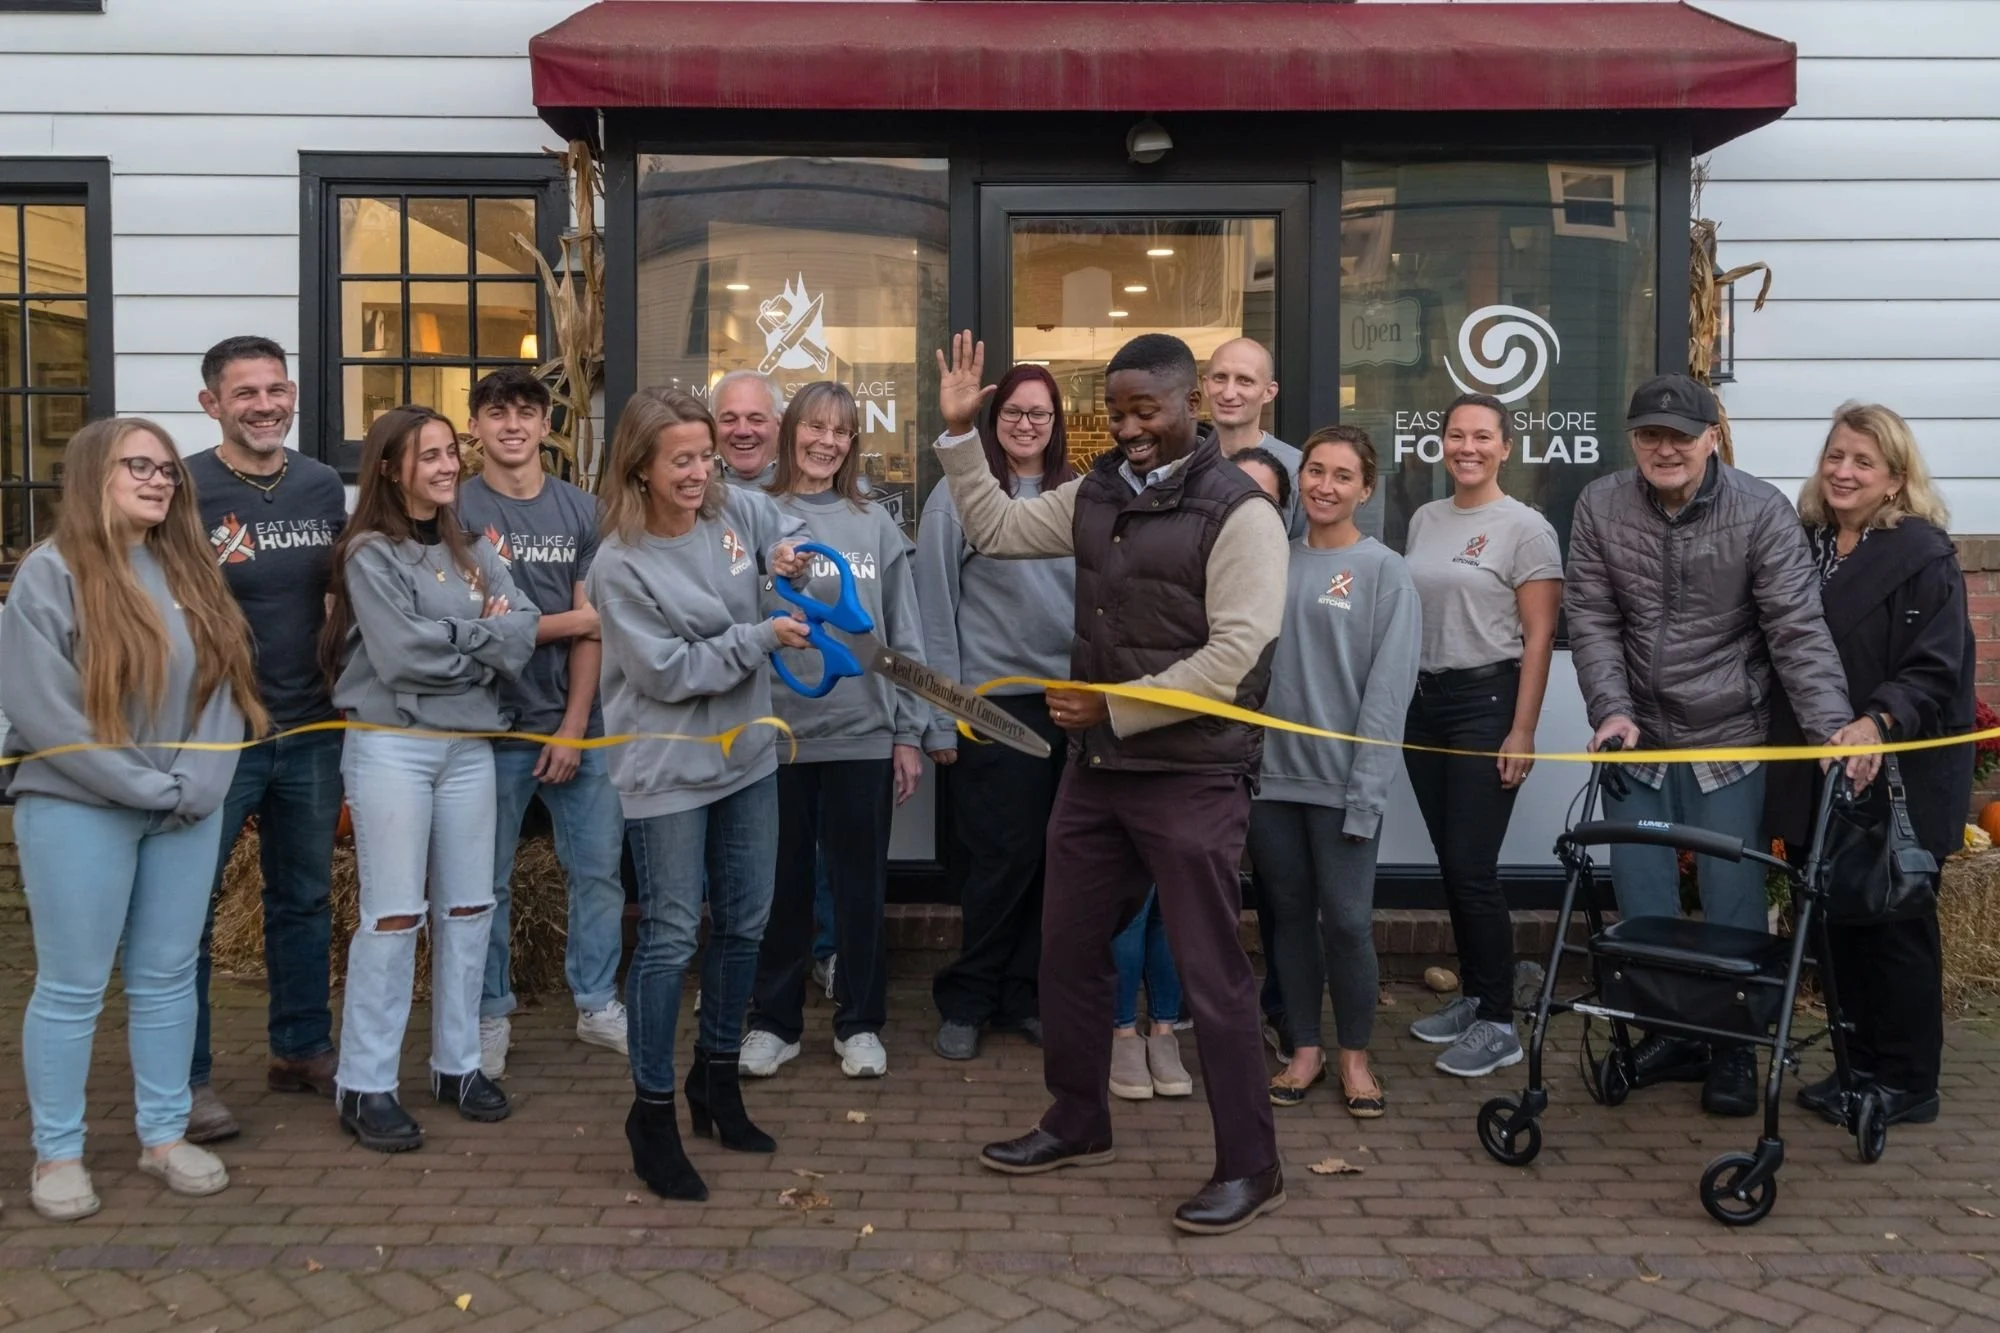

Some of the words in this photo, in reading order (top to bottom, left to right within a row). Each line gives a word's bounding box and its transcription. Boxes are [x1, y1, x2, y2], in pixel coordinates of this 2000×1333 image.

[1351, 316, 1401, 350] Open
[856, 381, 896, 397] AGE
[1514, 412, 1597, 431] SHORE
[1394, 434, 1444, 463] FO
[1522, 435, 1599, 464] LAB
[256, 520, 285, 535] EAT
[290, 519, 317, 532] LIKE
[322, 519, 331, 530] A
[257, 531, 333, 550] HUMAN
[533, 535, 564, 547] LIKE
[566, 535, 576, 547] A
[863, 552, 875, 564] A
[1318, 597, 1351, 610] KITCHEN
[892, 656, 912, 682] Kent
[925, 674, 964, 707] Chamber
[965, 695, 977, 713] of
[977, 701, 1025, 739] Commerce
[1638, 819, 1669, 829] LUMEX
